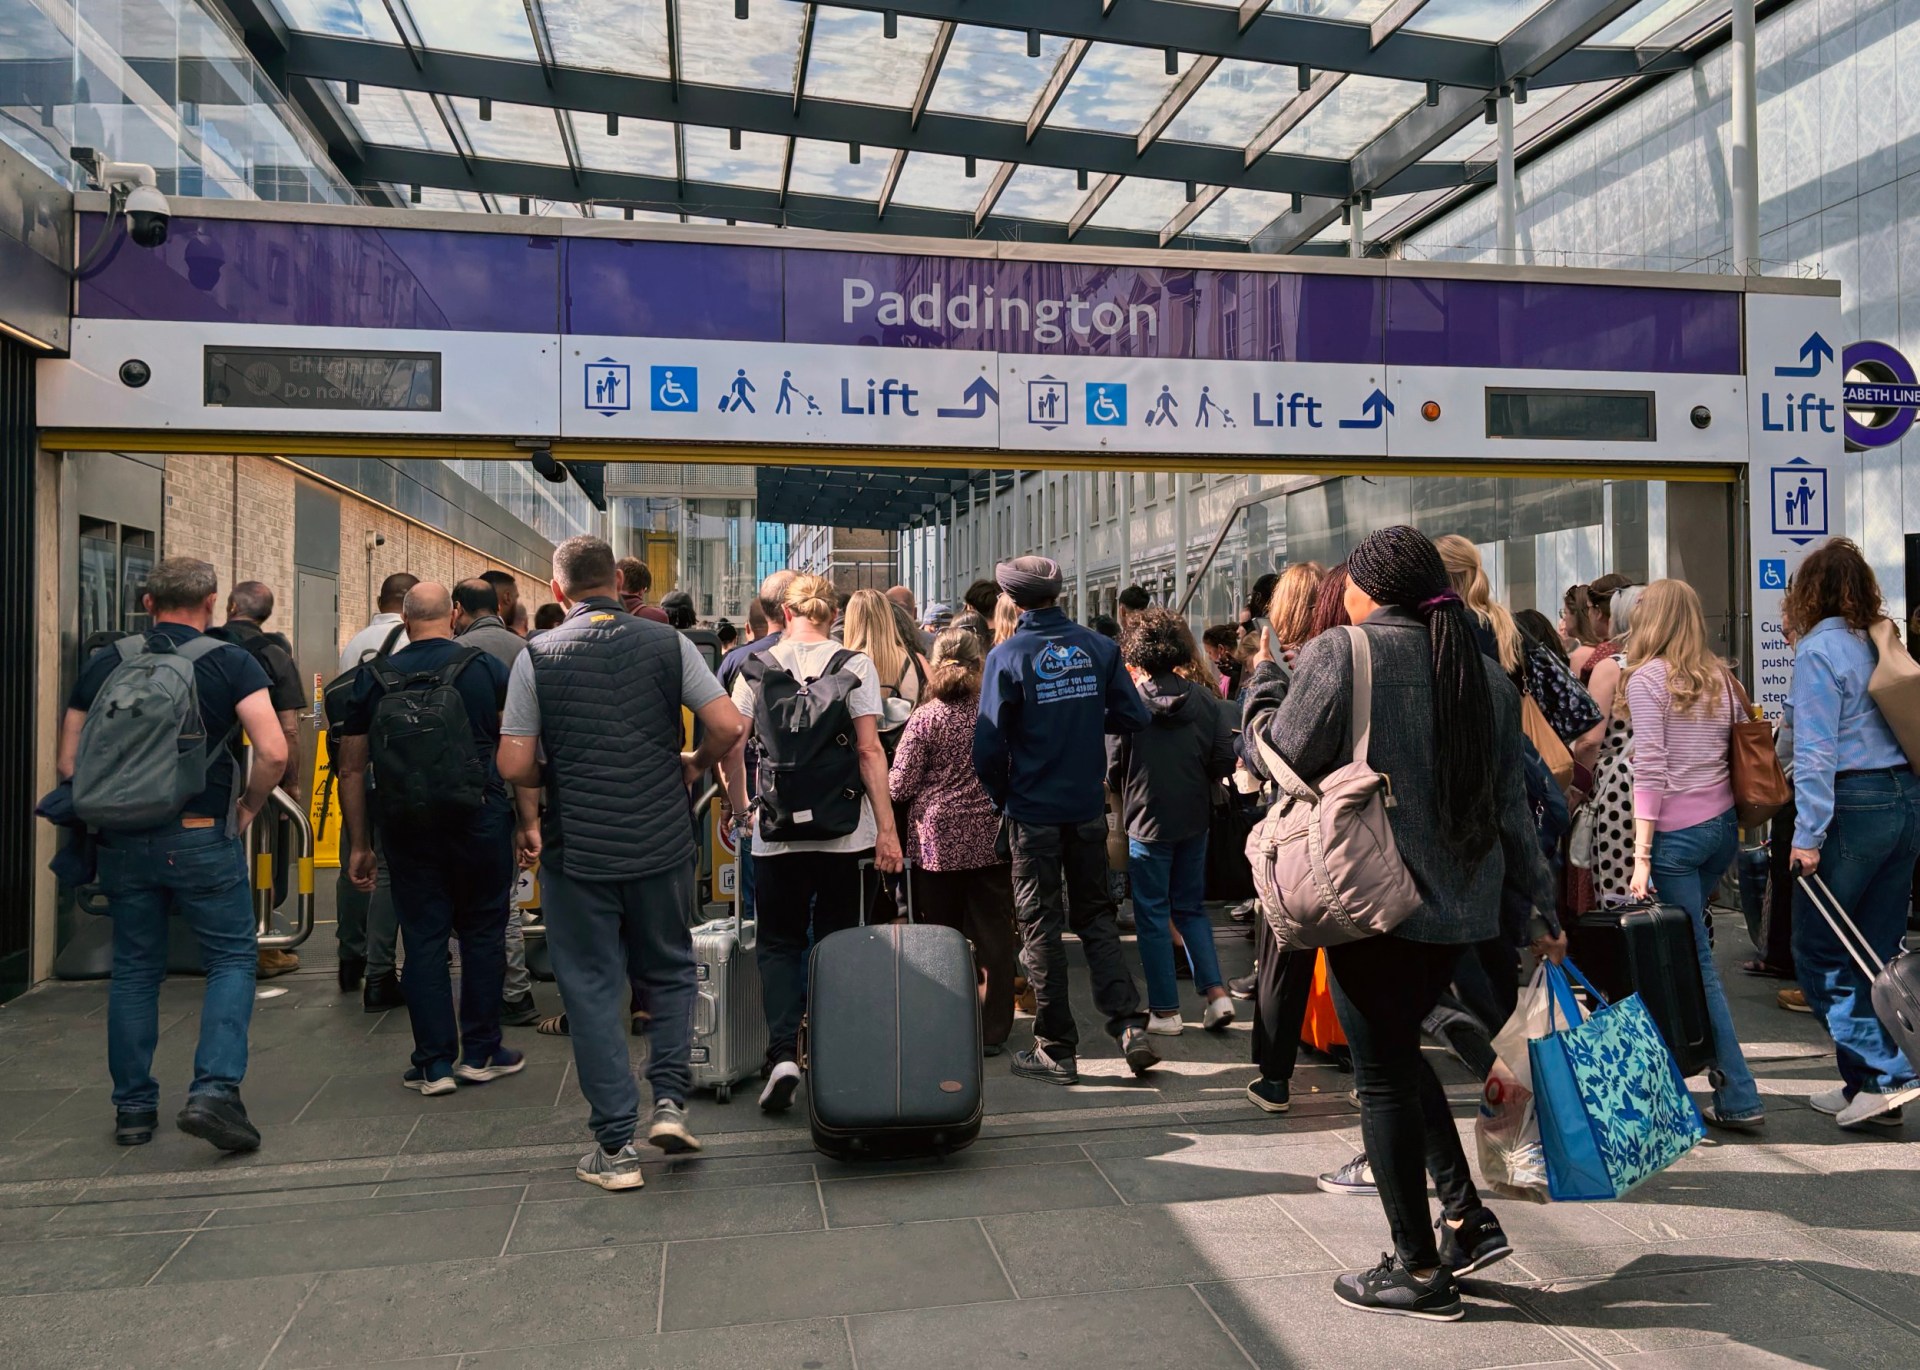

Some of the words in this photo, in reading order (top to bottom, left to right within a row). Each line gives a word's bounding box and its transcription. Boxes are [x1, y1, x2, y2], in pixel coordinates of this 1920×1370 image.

[842, 277, 1158, 344] Paddington
[289, 356, 393, 379] Emergency
[284, 382, 311, 398] Do
[316, 384, 347, 400] not
[841, 378, 919, 417] Lift
[1842, 387, 1890, 401] ZABETH
[1893, 389, 1920, 403] LINE
[1253, 392, 1323, 428] Lift
[1761, 392, 1836, 433] Lift
[1761, 622, 1782, 632] Cus
[1761, 639, 1787, 650] with
[1762, 656, 1795, 669] pushc
[1762, 674, 1787, 684] who
[1763, 711, 1783, 720] acc
[1480, 1222, 1499, 1233] FILA
